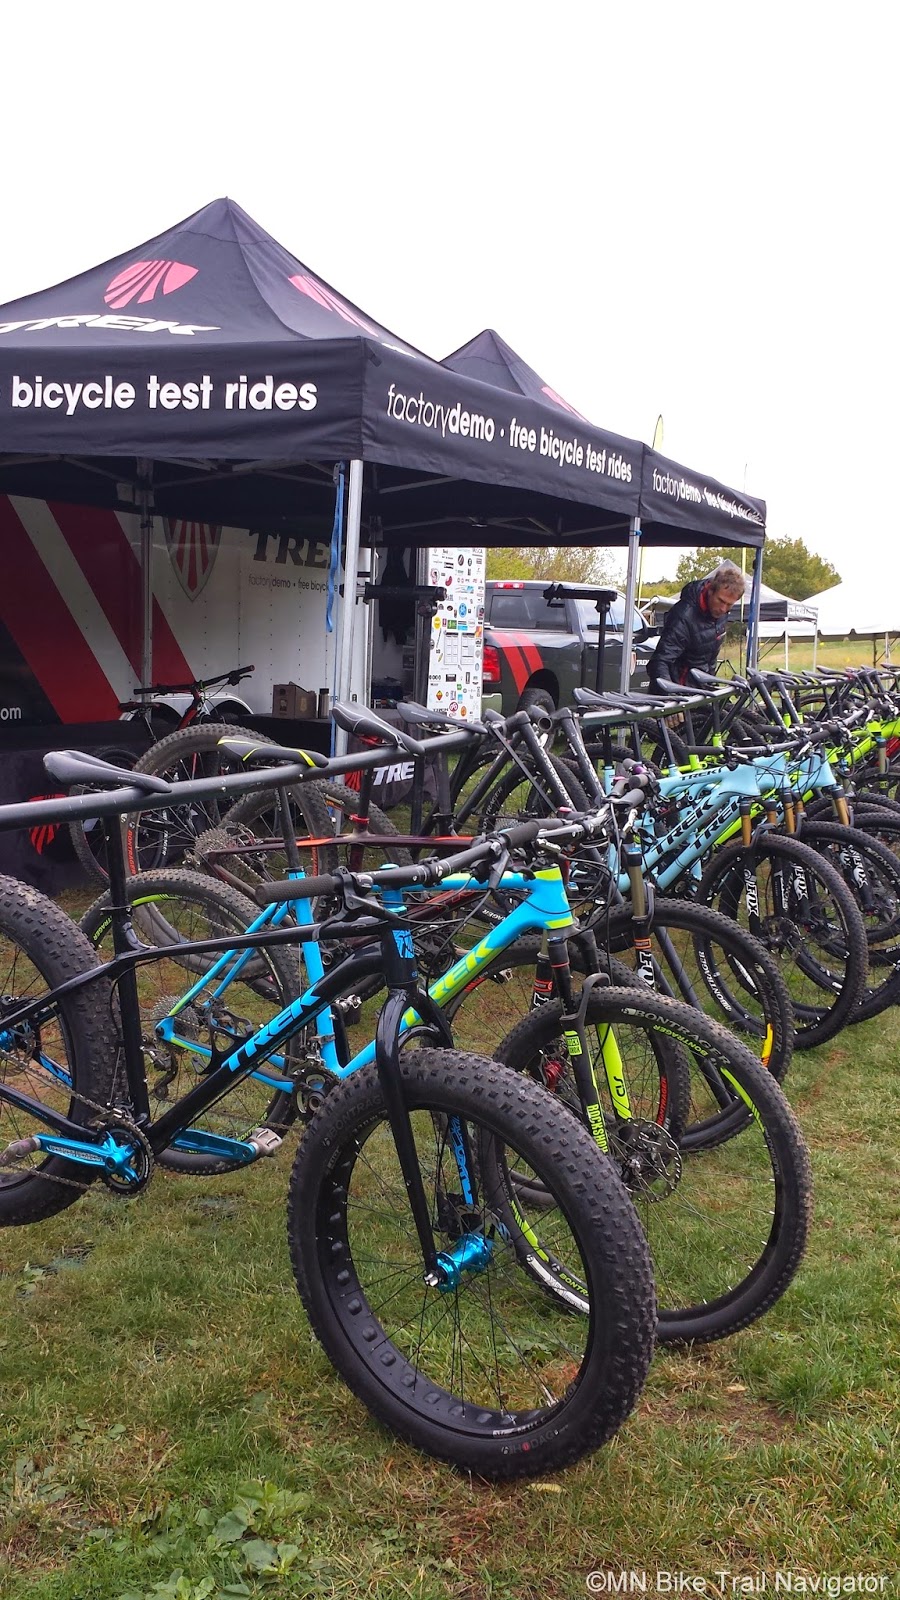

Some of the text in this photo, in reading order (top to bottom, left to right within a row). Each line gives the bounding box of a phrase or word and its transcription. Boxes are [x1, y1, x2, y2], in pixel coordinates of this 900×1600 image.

[11, 375, 318, 416] bicycle test rides
[387, 383, 632, 483] factorydemo free bicycle test rides
[652, 468, 702, 503] factorydemo
[249, 529, 346, 571] TRE
[311, 580, 329, 593] bicycl
[373, 761, 415, 786] TRE
[651, 803, 714, 855] TREK
[127, 829, 137, 876] BONTRAGER
[745, 880, 760, 917] FOX
[637, 951, 656, 990] FO
[698, 950, 732, 1012] BONTRAGER
[221, 983, 321, 1072] TREK
[635, 1009, 731, 1065] BONTRAGER
[653, 1024, 709, 1057] BONTRAGER
